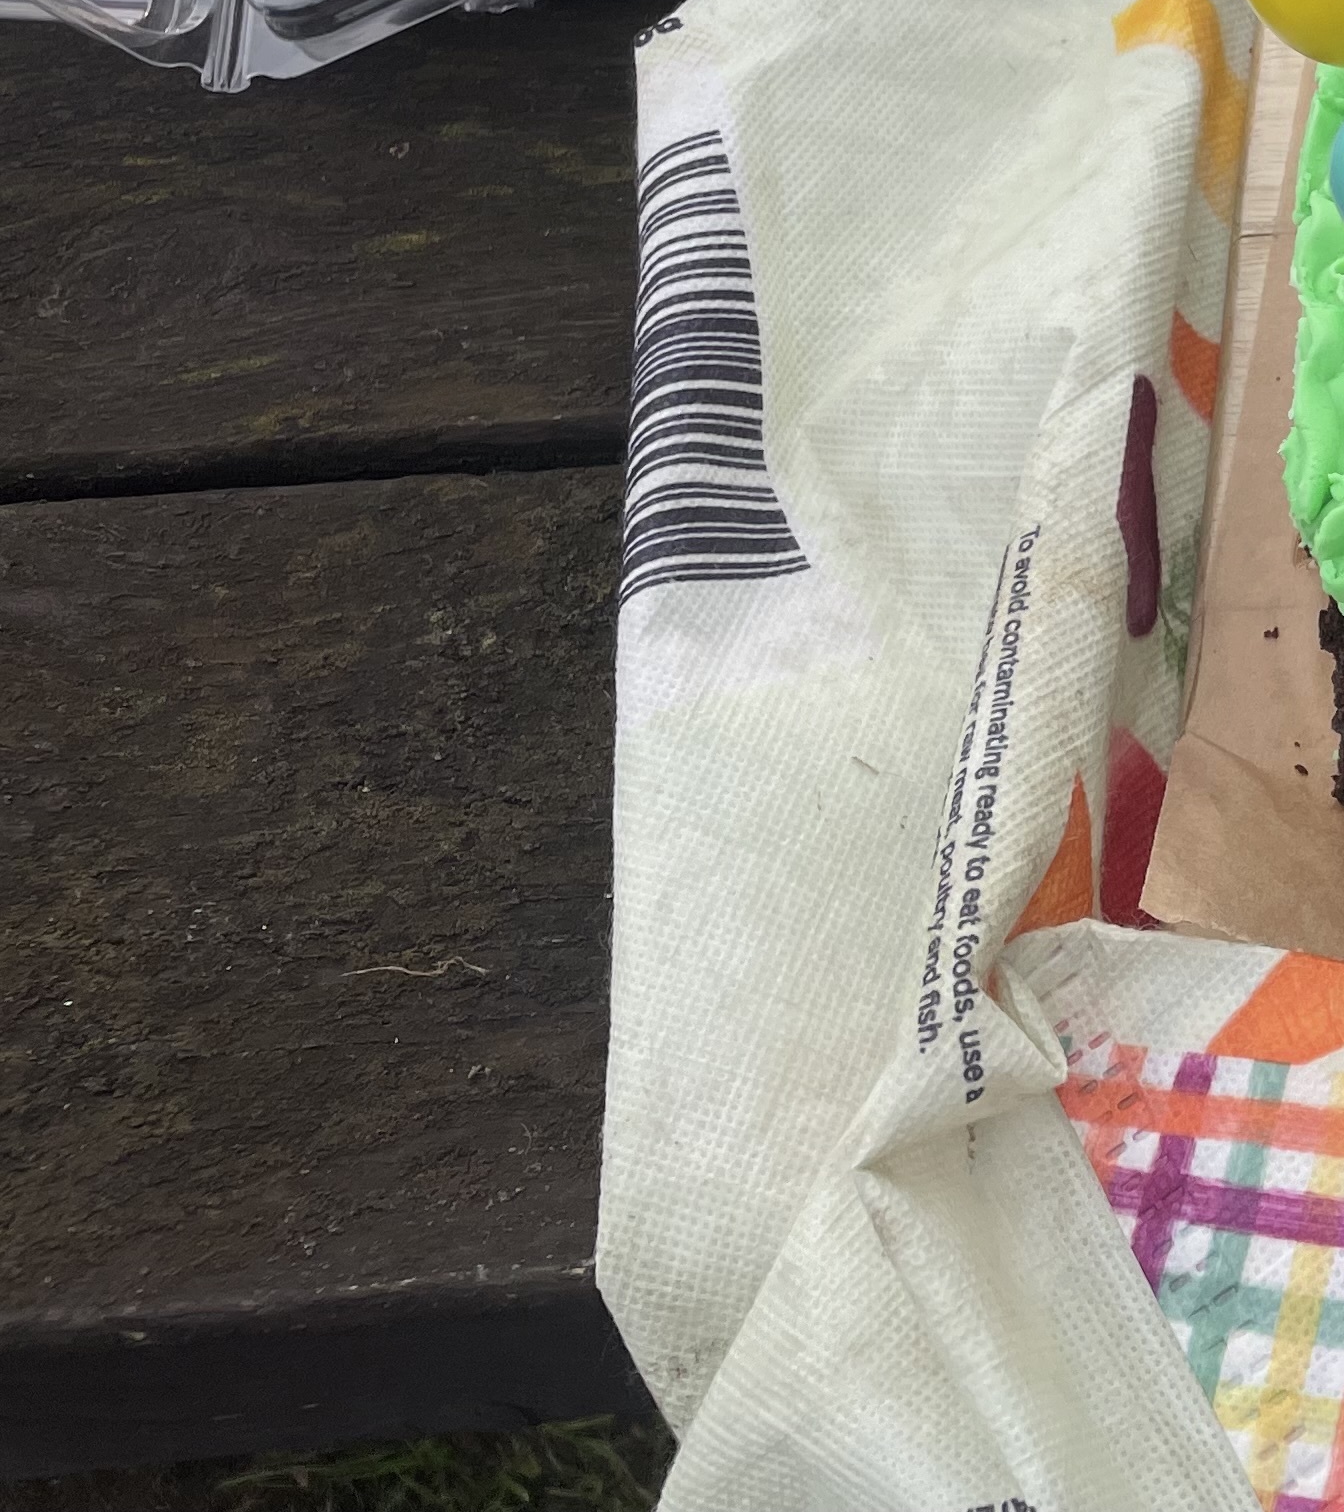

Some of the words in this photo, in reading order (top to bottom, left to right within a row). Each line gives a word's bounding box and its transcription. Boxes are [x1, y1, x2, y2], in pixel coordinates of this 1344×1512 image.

[1018, 524, 1041, 553] To
[1007, 557, 1032, 614] avoid
[974, 619, 1022, 780] contaminating
[964, 784, 997, 849] ready
[928, 840, 956, 932] poultry
[965, 855, 991, 882] to
[957, 887, 982, 930] eat
[922, 937, 941, 988] and
[952, 934, 980, 1023] foods,
[918, 989, 943, 1054] fish.
[958, 1029, 984, 1083] use
